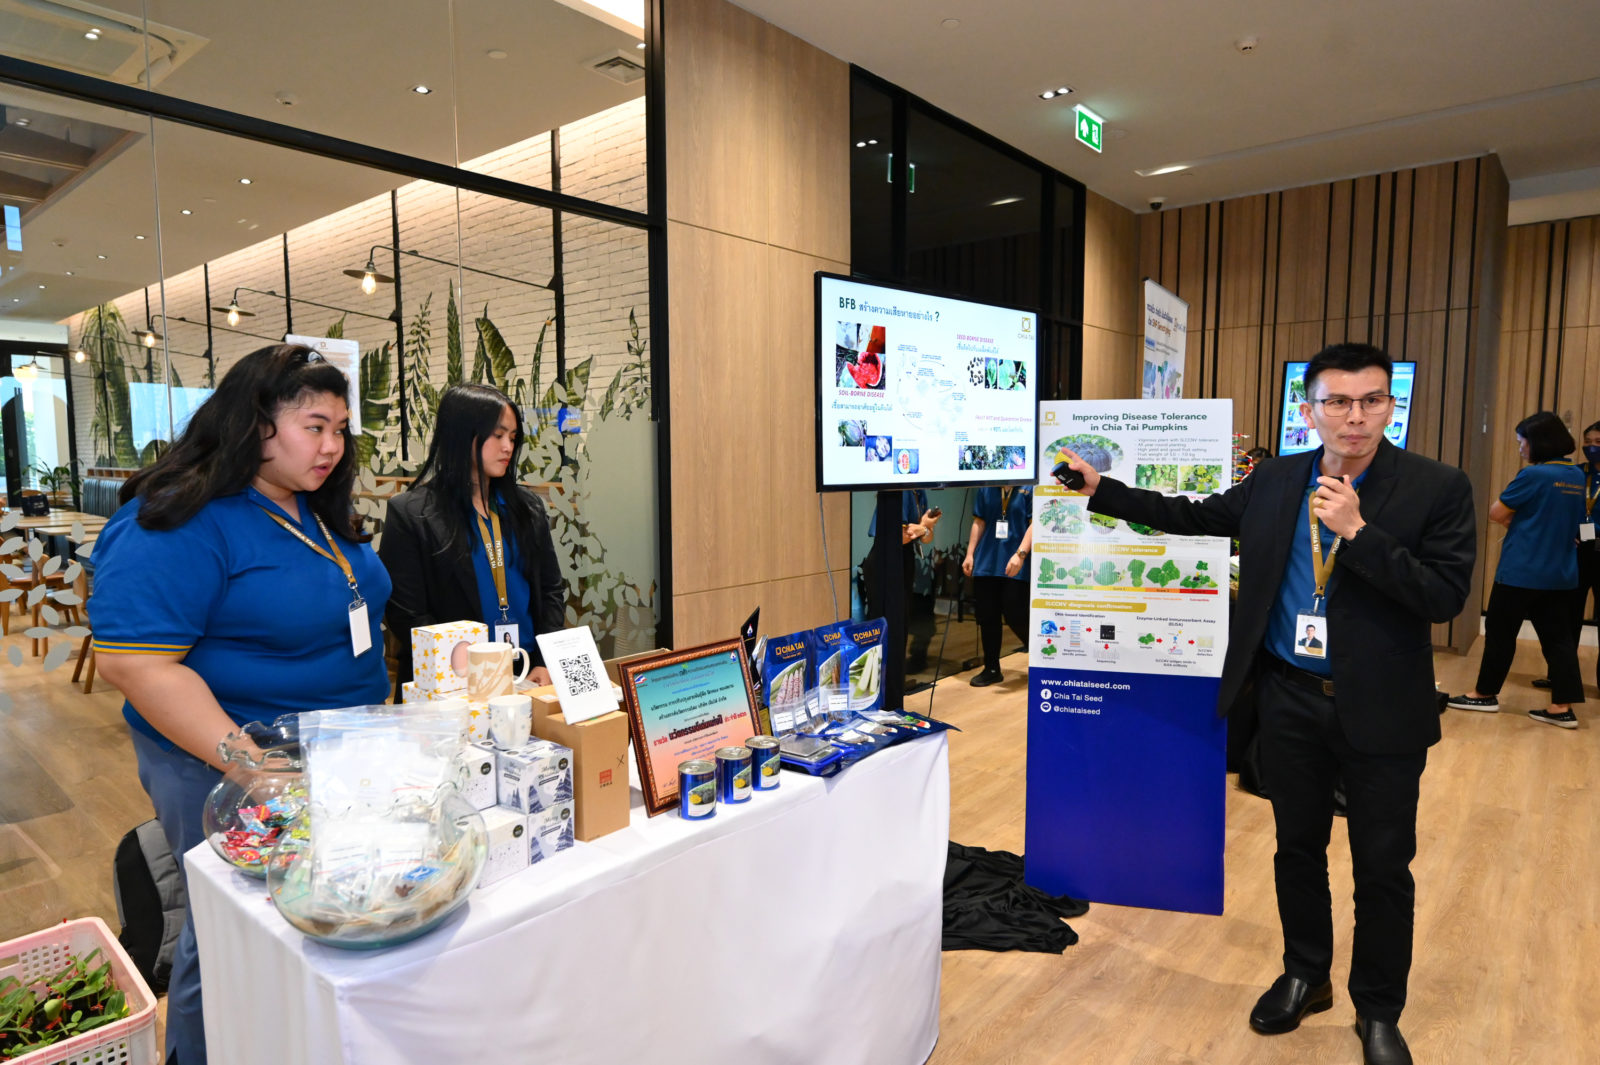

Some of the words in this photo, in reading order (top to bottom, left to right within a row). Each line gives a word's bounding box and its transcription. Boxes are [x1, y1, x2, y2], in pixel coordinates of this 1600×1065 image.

[840, 296, 856, 310] BFB
[935, 311, 940, 322] ?
[1072, 413, 1119, 422] Improving
[1122, 413, 1158, 421] Disease
[1160, 412, 1208, 421] Tolerance
[1102, 424, 1122, 432] Chia
[1126, 424, 1140, 432] Tai
[1142, 424, 1188, 432] Pumpkins
[858, 630, 872, 640] CHIA
[872, 628, 880, 636] TAI
[782, 644, 796, 654] CHIA
[794, 641, 804, 650] TAI
[1041, 679, 1131, 690] www.chiataiseed.com
[1054, 692, 1070, 700] Chia
[1072, 693, 1082, 701] Tai
[1084, 694, 1103, 702] Seed
[1054, 705, 1101, 715] @chiataiseed
